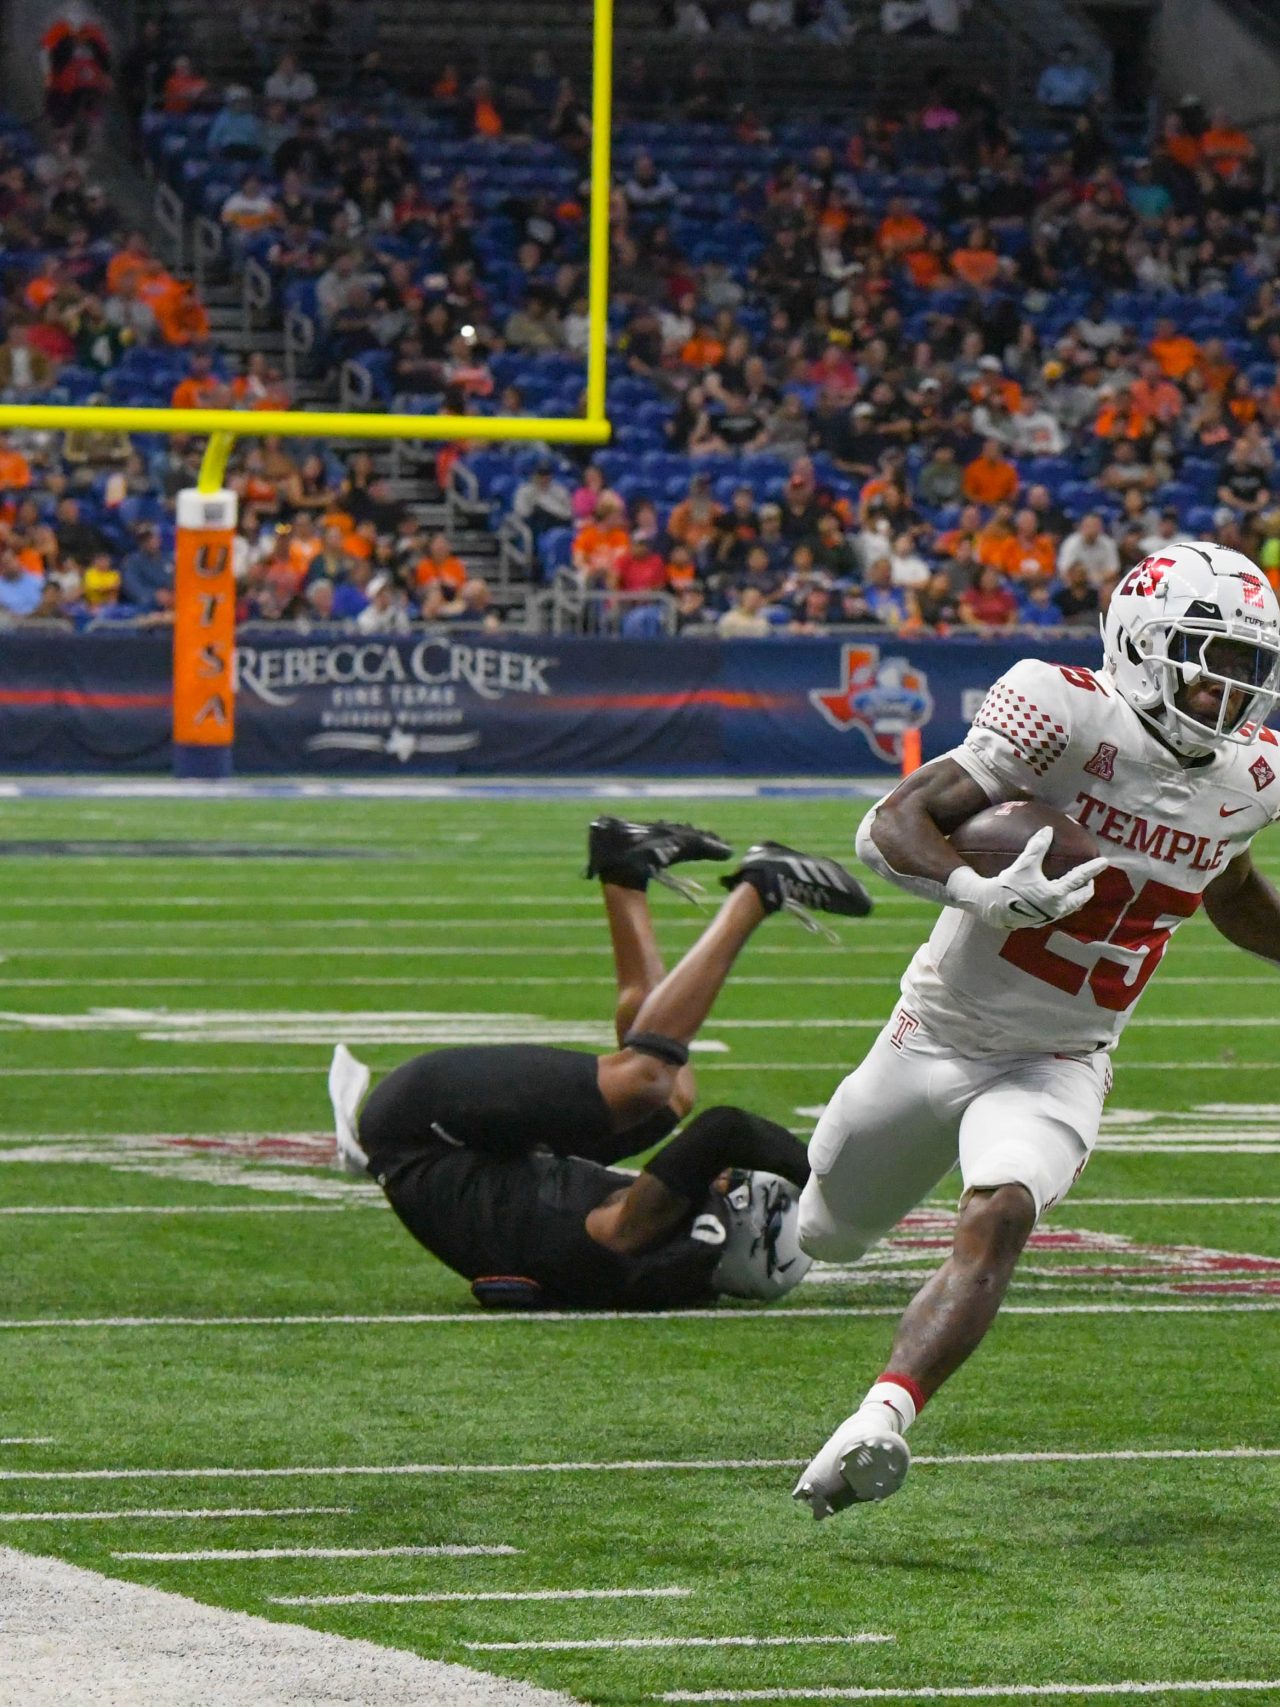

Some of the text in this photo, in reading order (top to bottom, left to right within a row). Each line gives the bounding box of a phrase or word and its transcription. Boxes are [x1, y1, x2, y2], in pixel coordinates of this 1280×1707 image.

[193, 543, 229, 727] UTSA
[232, 637, 550, 706] REBECCA CREEK
[1074, 791, 1231, 872] TEMPLE
[998, 865, 1202, 1012] 25
[890, 1008, 919, 1050] T
